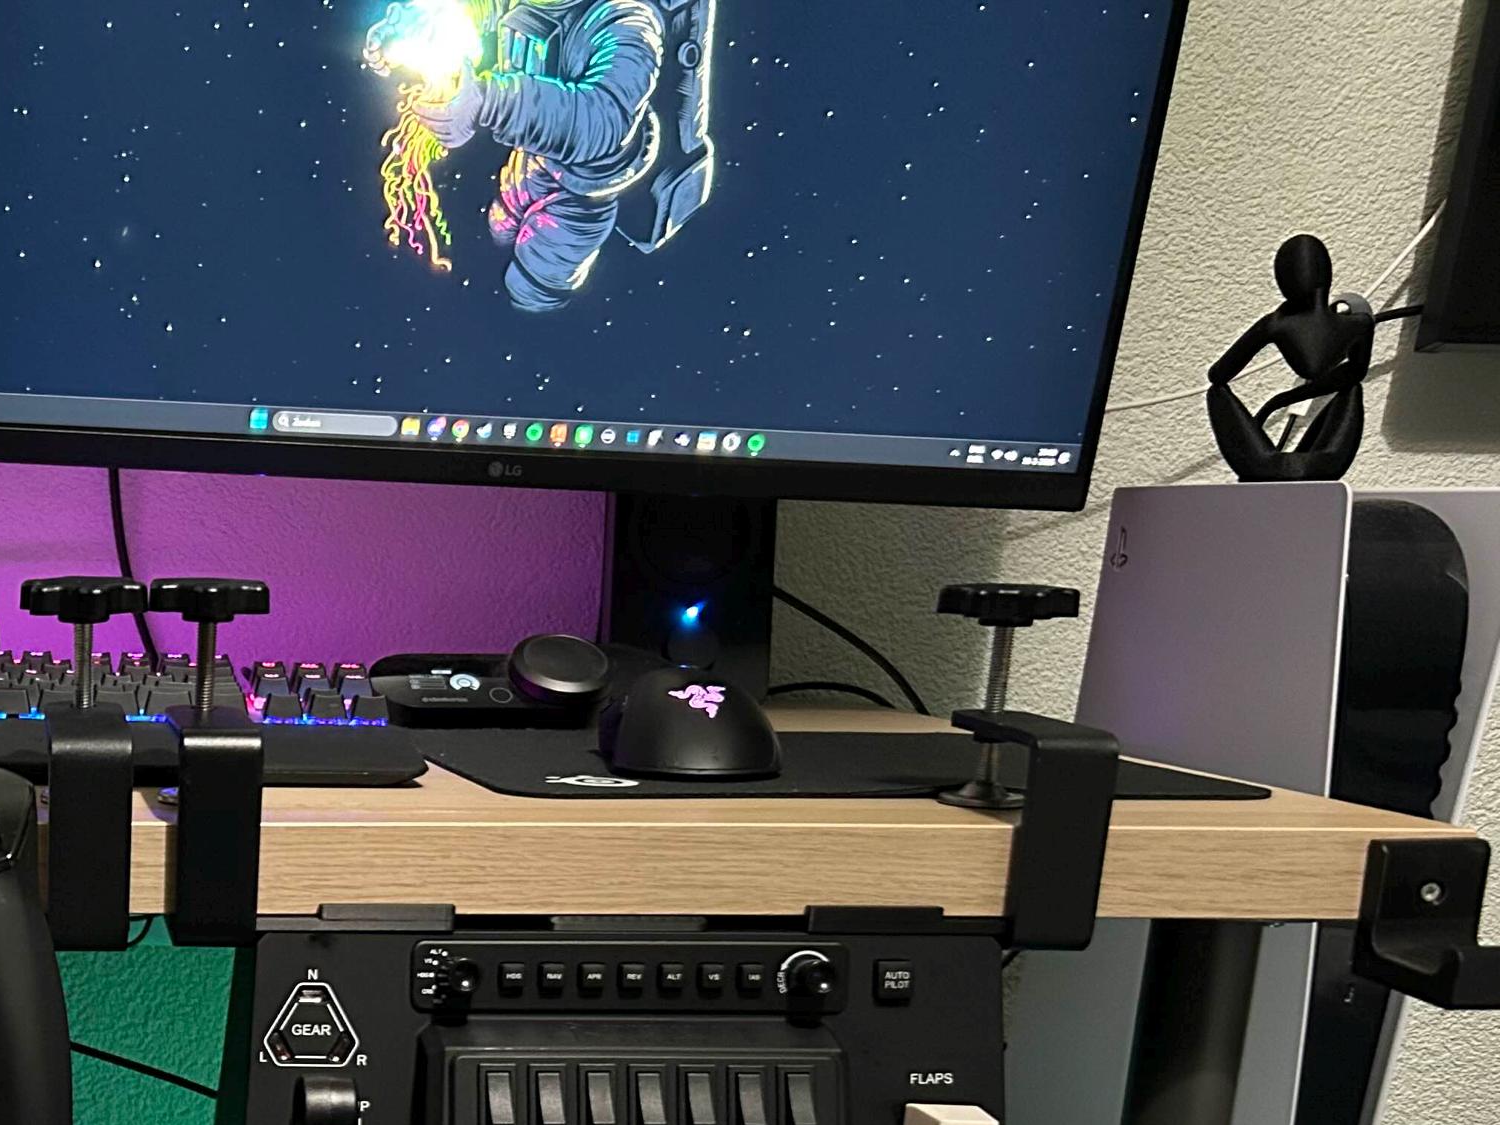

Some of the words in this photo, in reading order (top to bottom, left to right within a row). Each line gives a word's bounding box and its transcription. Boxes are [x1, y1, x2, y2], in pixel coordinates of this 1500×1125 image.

[505, 464, 523, 477] LG
[307, 968, 319, 980] N
[708, 973, 721, 981] VS
[884, 971, 911, 980] AUTO
[884, 980, 910, 989] PILOT
[291, 1024, 332, 1036] GEAR
[260, 1051, 268, 1063] L
[356, 1054, 368, 1066] R
[910, 1072, 954, 1085] FLAPS
